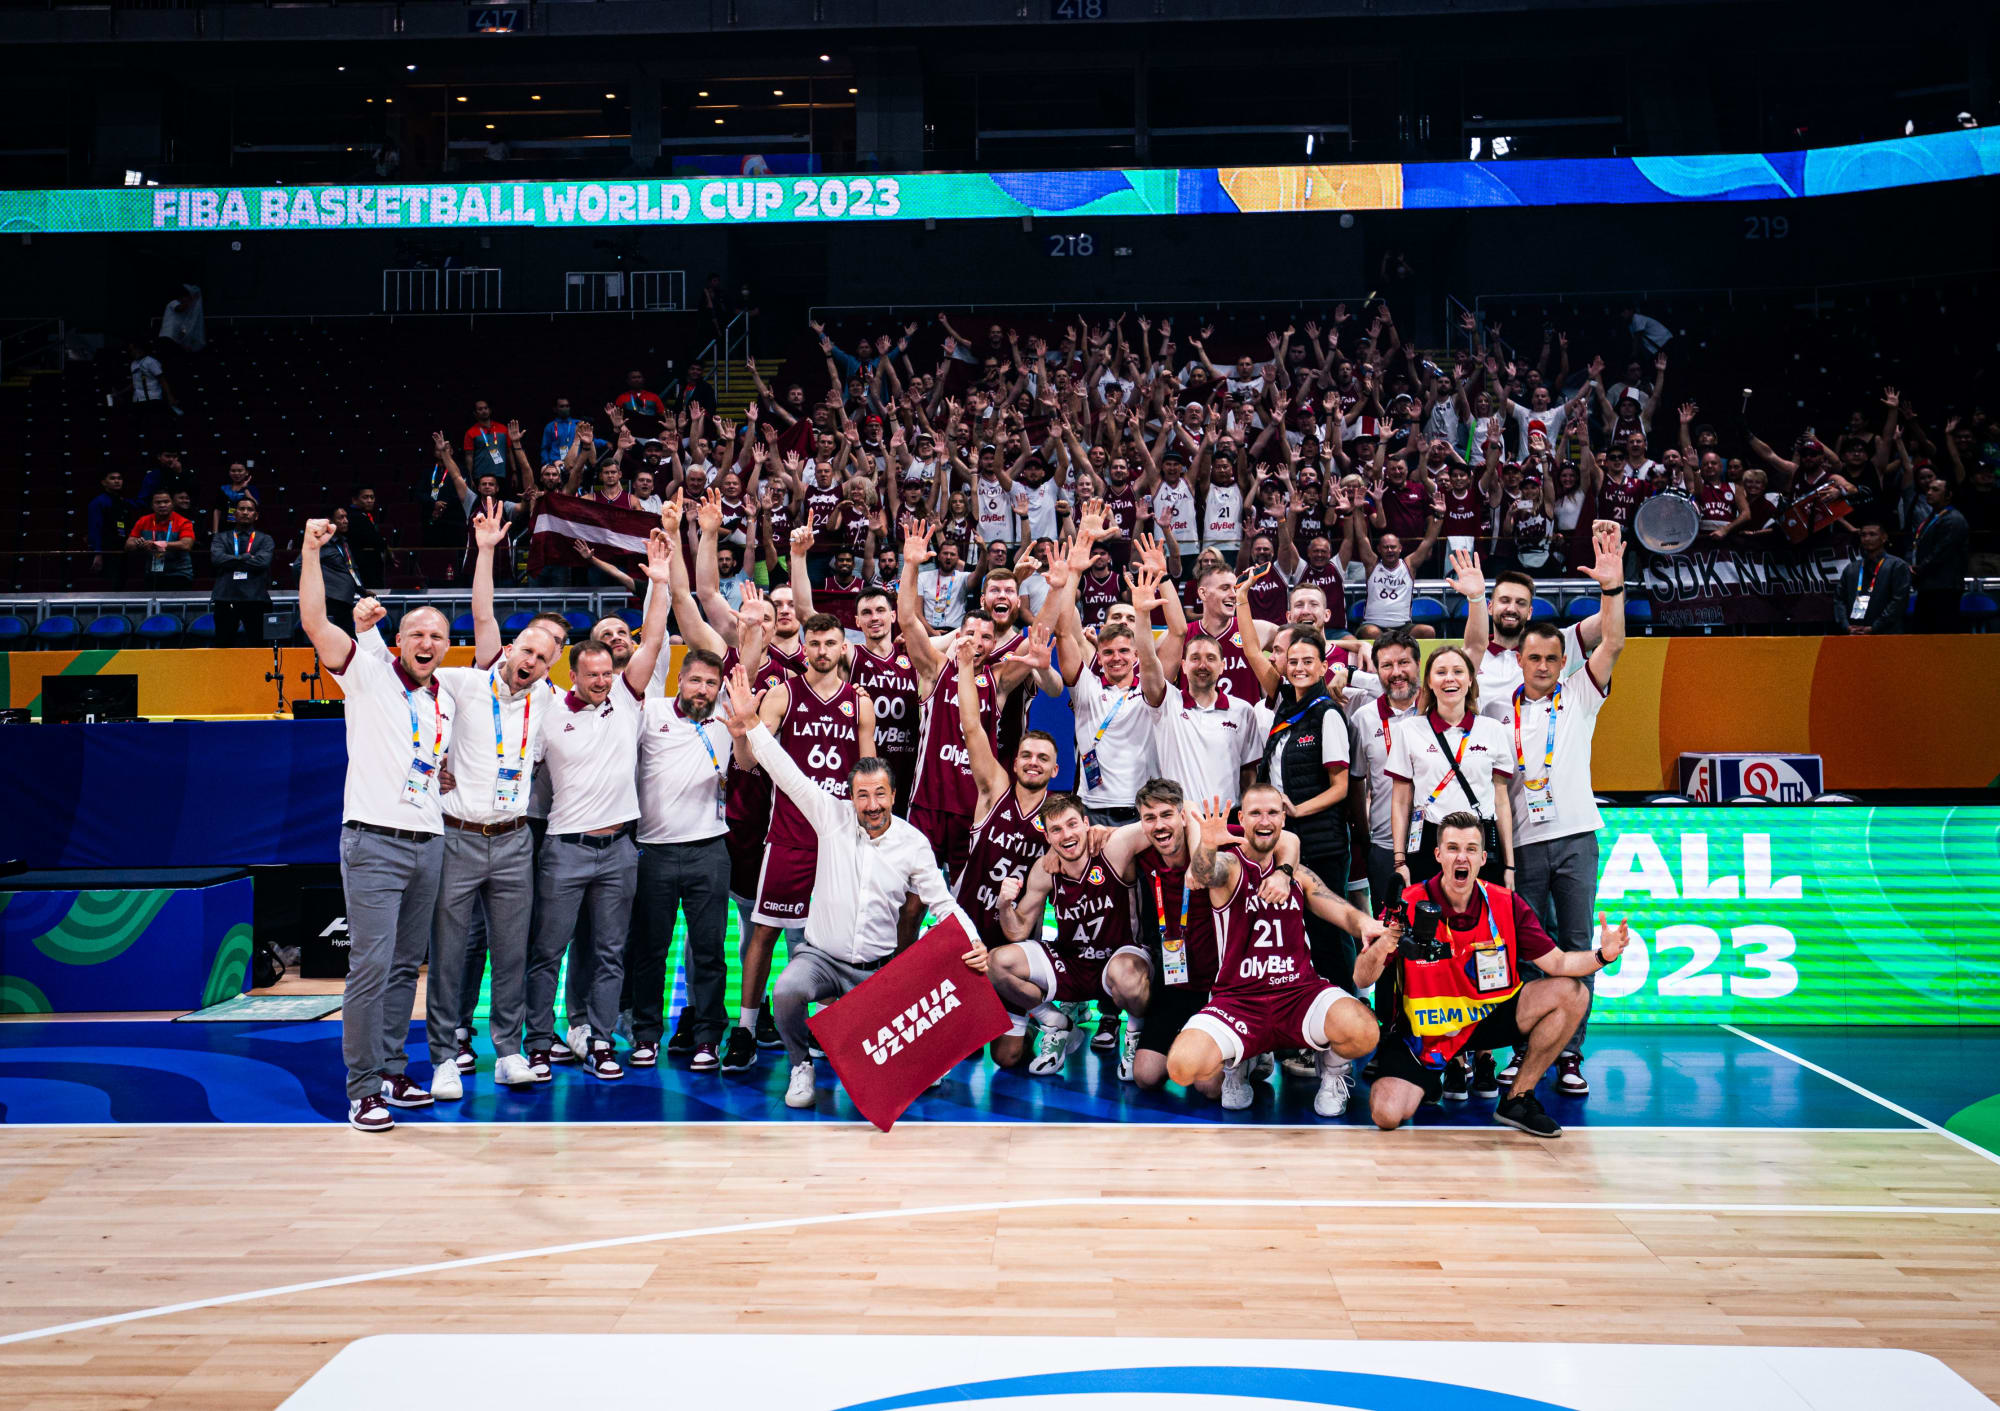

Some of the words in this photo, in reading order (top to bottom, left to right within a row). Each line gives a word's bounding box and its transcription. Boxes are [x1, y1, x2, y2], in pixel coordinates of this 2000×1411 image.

[475, 9, 518, 30] 417
[1057, 0, 1102, 19] 418
[152, 190, 250, 228] FIBA
[260, 185, 535, 227] BASKETBALL
[543, 183, 691, 222] WORLD
[700, 181, 784, 220] CUP
[793, 178, 901, 217] 2023
[1744, 216, 1789, 240] 219
[1049, 232, 1094, 256] 218
[989, 499, 997, 510] 6
[1605, 491, 1635, 504] LAVIJA
[1218, 507, 1230, 518] 21
[1613, 507, 1627, 520] 21
[1650, 549, 1731, 602] SDK
[1730, 547, 1842, 596] NAME
[1085, 595, 1117, 604] LATVIJA
[1380, 590, 1399, 600] 66
[1097, 608, 1105, 619] 6
[860, 673, 916, 691] LATVIJA
[874, 695, 905, 719] 00
[793, 721, 855, 741] LATVIJA
[874, 725, 910, 745] lyBet
[807, 744, 842, 770] 66
[940, 744, 970, 766] OlyB
[809, 776, 849, 796] lyBet
[988, 826, 1046, 858] LATVIJA
[989, 857, 1028, 884] 55
[763, 901, 794, 912] CIRCLE
[1056, 894, 1114, 920] LATVIJA
[1073, 916, 1105, 944] 47
[1253, 918, 1284, 948] 21
[331, 938, 350, 948] Hype
[1240, 955, 1295, 979] OlyBet
[1592, 924, 1799, 998] 023
[862, 978, 957, 1056] LATVIJA
[1415, 1008, 1463, 1026] TEAM
[872, 993, 962, 1065] UZVARA
